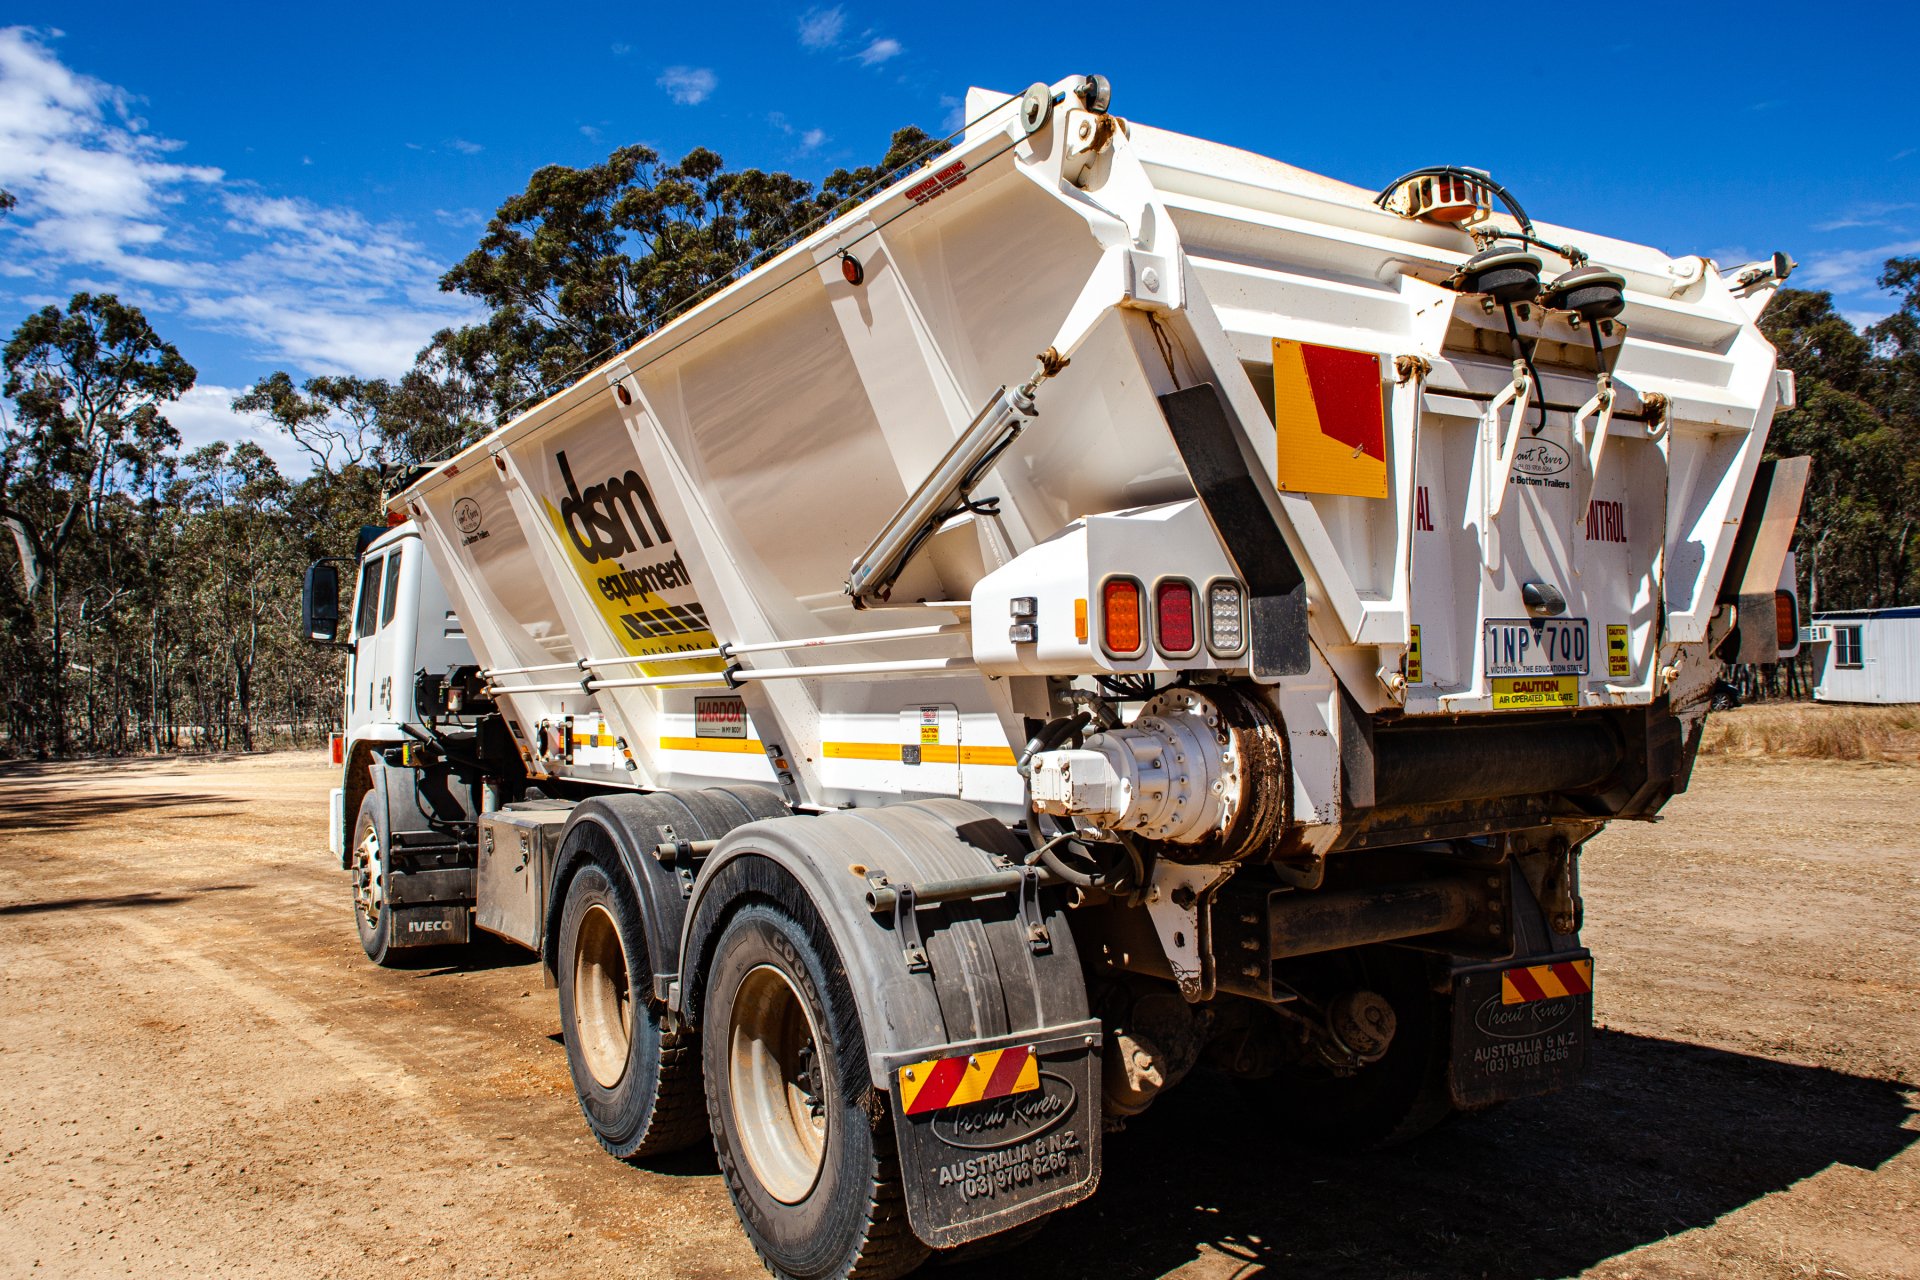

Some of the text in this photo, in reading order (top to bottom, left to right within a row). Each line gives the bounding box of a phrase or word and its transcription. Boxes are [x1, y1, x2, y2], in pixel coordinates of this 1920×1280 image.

[1538, 446, 1562, 465] River
[1516, 475, 1542, 486] Bottom
[1543, 478, 1570, 489] Trailers
[556, 450, 672, 564] dsm
[598, 549, 692, 606] equipment
[1490, 627, 1529, 663] 1NP
[1491, 666, 1518, 674] VICTORIA
[1535, 665, 1566, 673] EDUCATION
[1567, 664, 1583, 672] STATE
[1499, 693, 1573, 704] AIR OPERATED TAIL GATE
[1513, 681, 1559, 693] CAUTION
[697, 701, 742, 722] HARDOX
[408, 920, 453, 933] IVECO
[1486, 1000, 1566, 1026] Trout River
[1474, 1032, 1577, 1062] AUSTRALIA & N.Z.
[1485, 1047, 1569, 1076] (03) 9708 6266
[939, 1130, 1080, 1186] AUSTRALIA & N.Z.
[960, 1151, 1067, 1203] (03) 9708 6266
